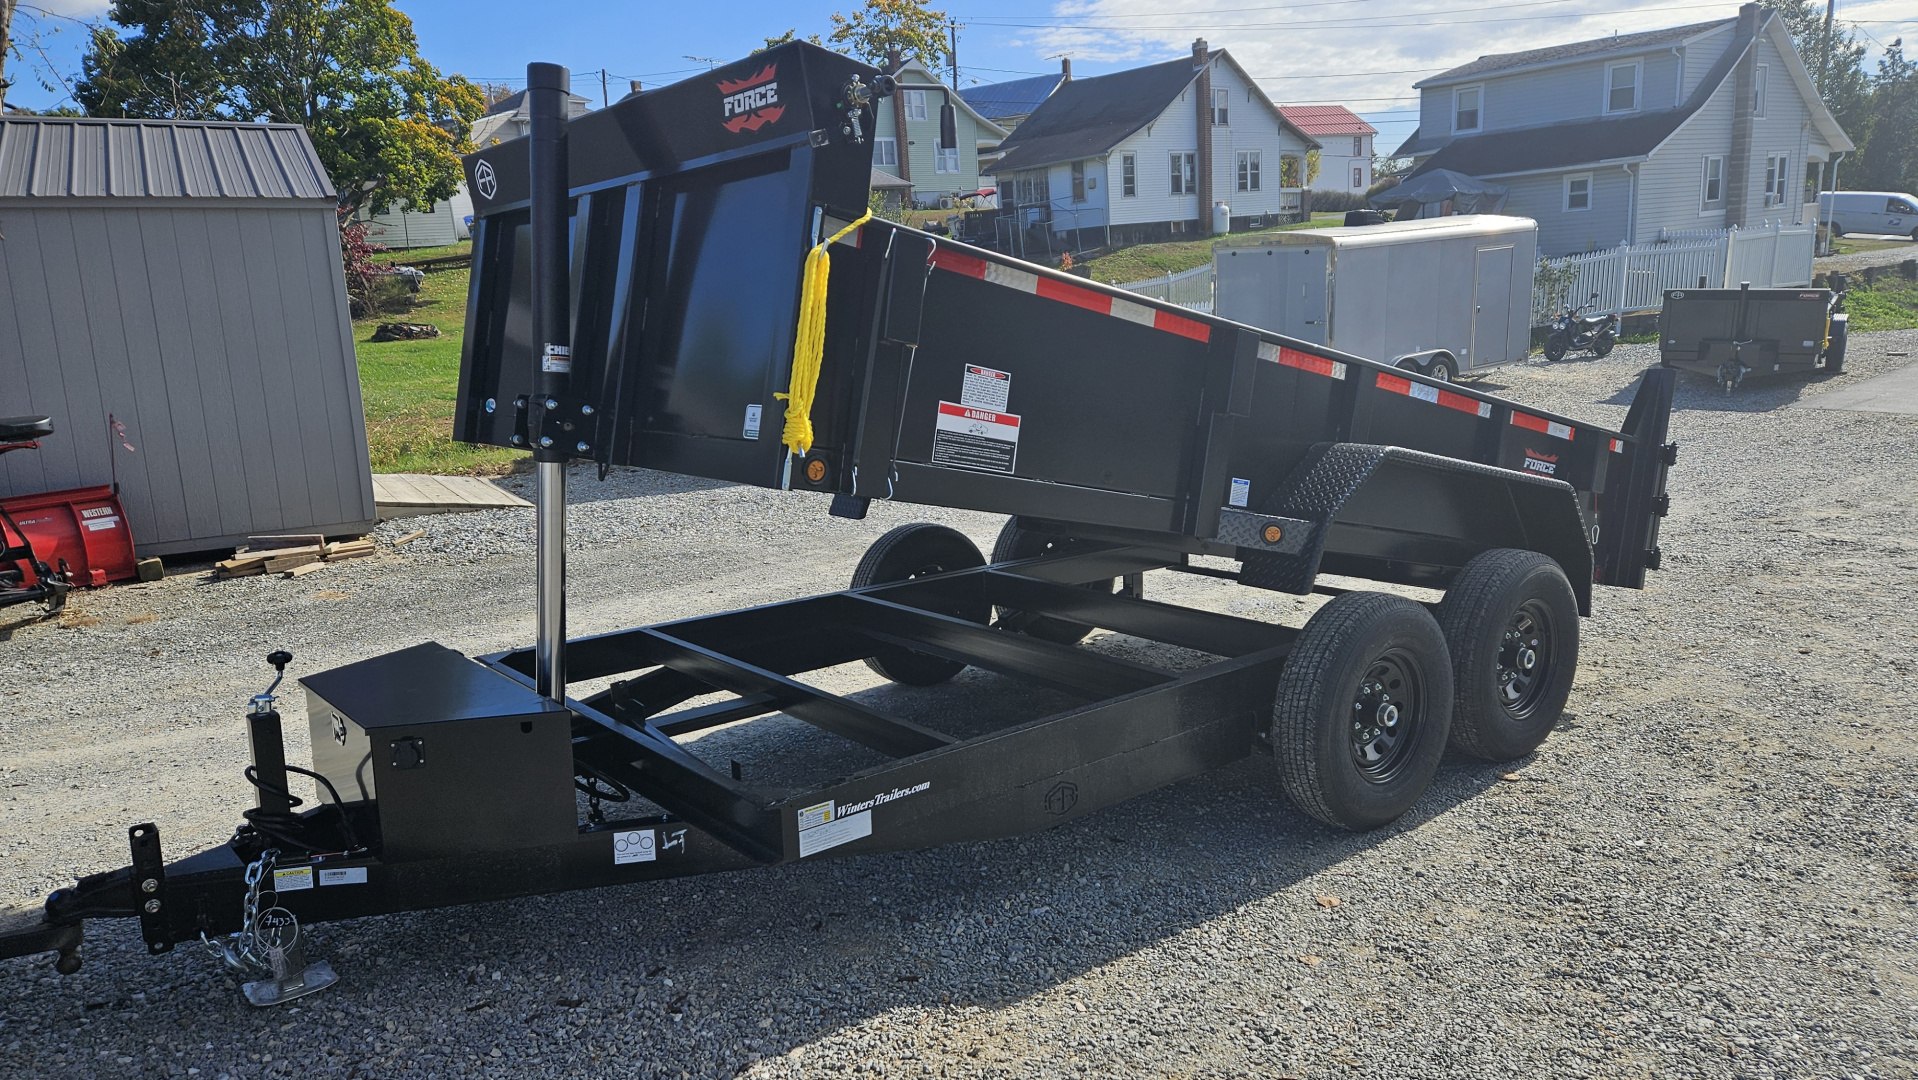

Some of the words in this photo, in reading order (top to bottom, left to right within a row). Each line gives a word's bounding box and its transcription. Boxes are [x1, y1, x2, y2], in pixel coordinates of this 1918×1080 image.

[723, 82, 778, 117] FORCE
[971, 411, 997, 422] DANGER
[1523, 457, 1557, 475] FORCE
[81, 506, 113, 519] WESTERN
[837, 781, 931, 819] WintersTrailers.com
